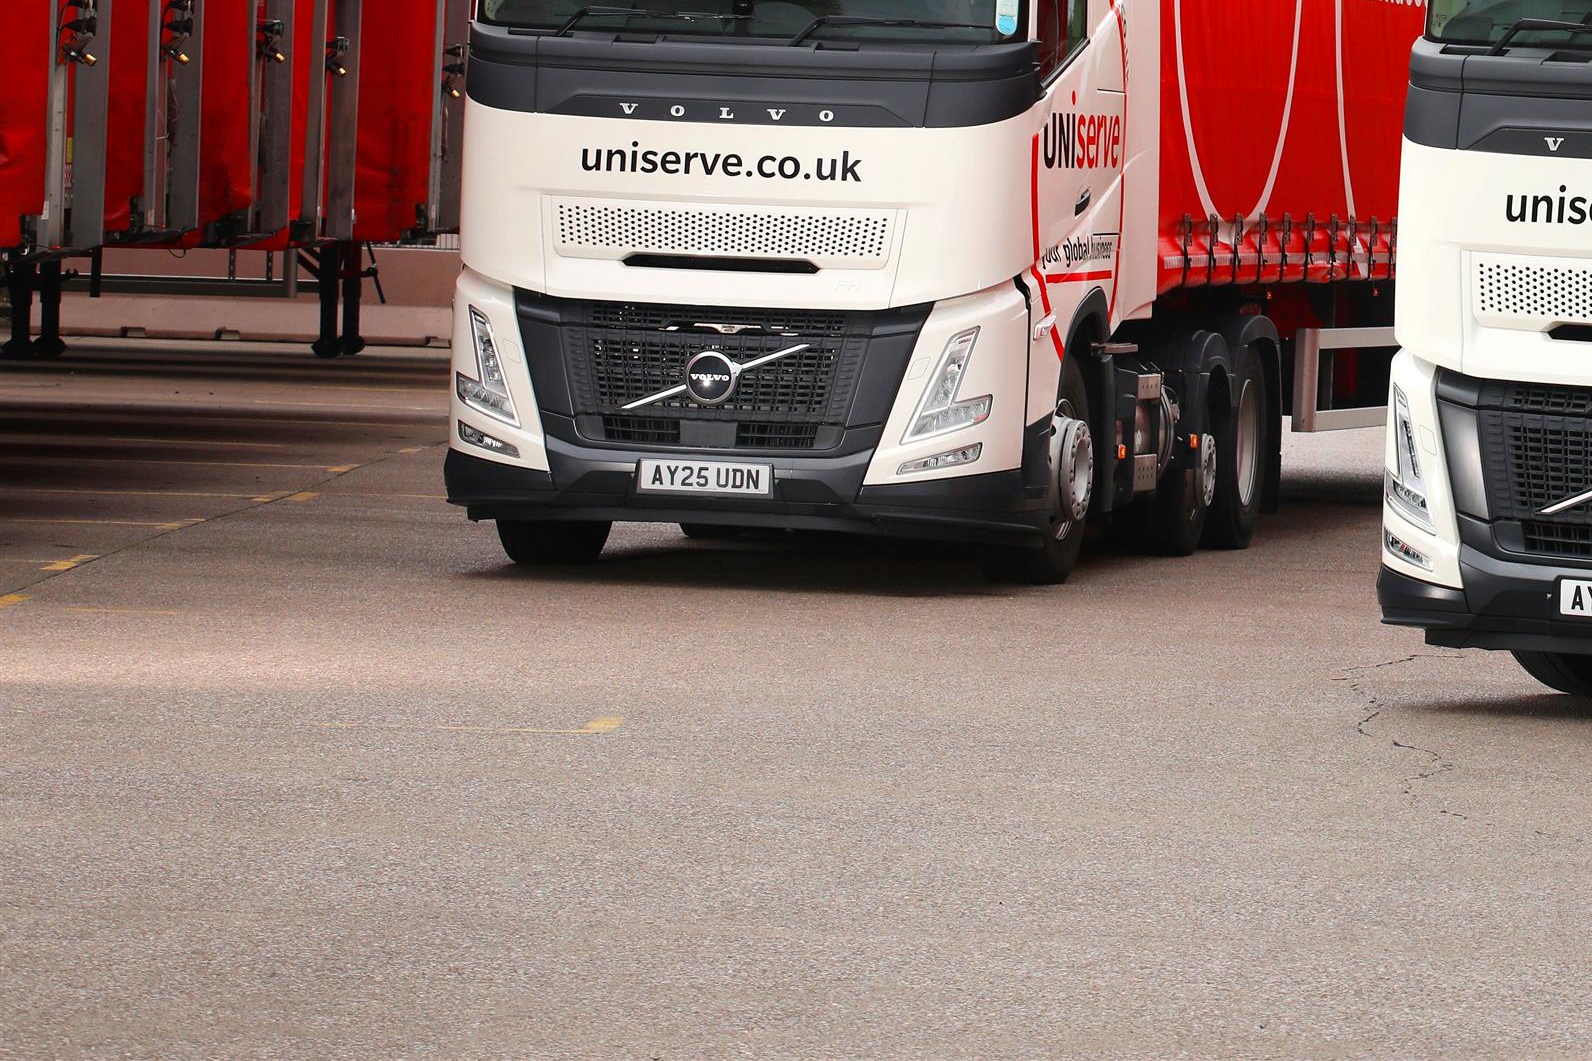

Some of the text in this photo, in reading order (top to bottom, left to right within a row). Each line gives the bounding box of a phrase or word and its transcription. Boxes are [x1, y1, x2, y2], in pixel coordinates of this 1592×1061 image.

[619, 102, 834, 121] VOLVO
[581, 140, 862, 182] uniserve.co.uk
[1063, 235, 1090, 268] global
[690, 373, 730, 381] VOLVO
[651, 465, 760, 490] AY25 UDN
